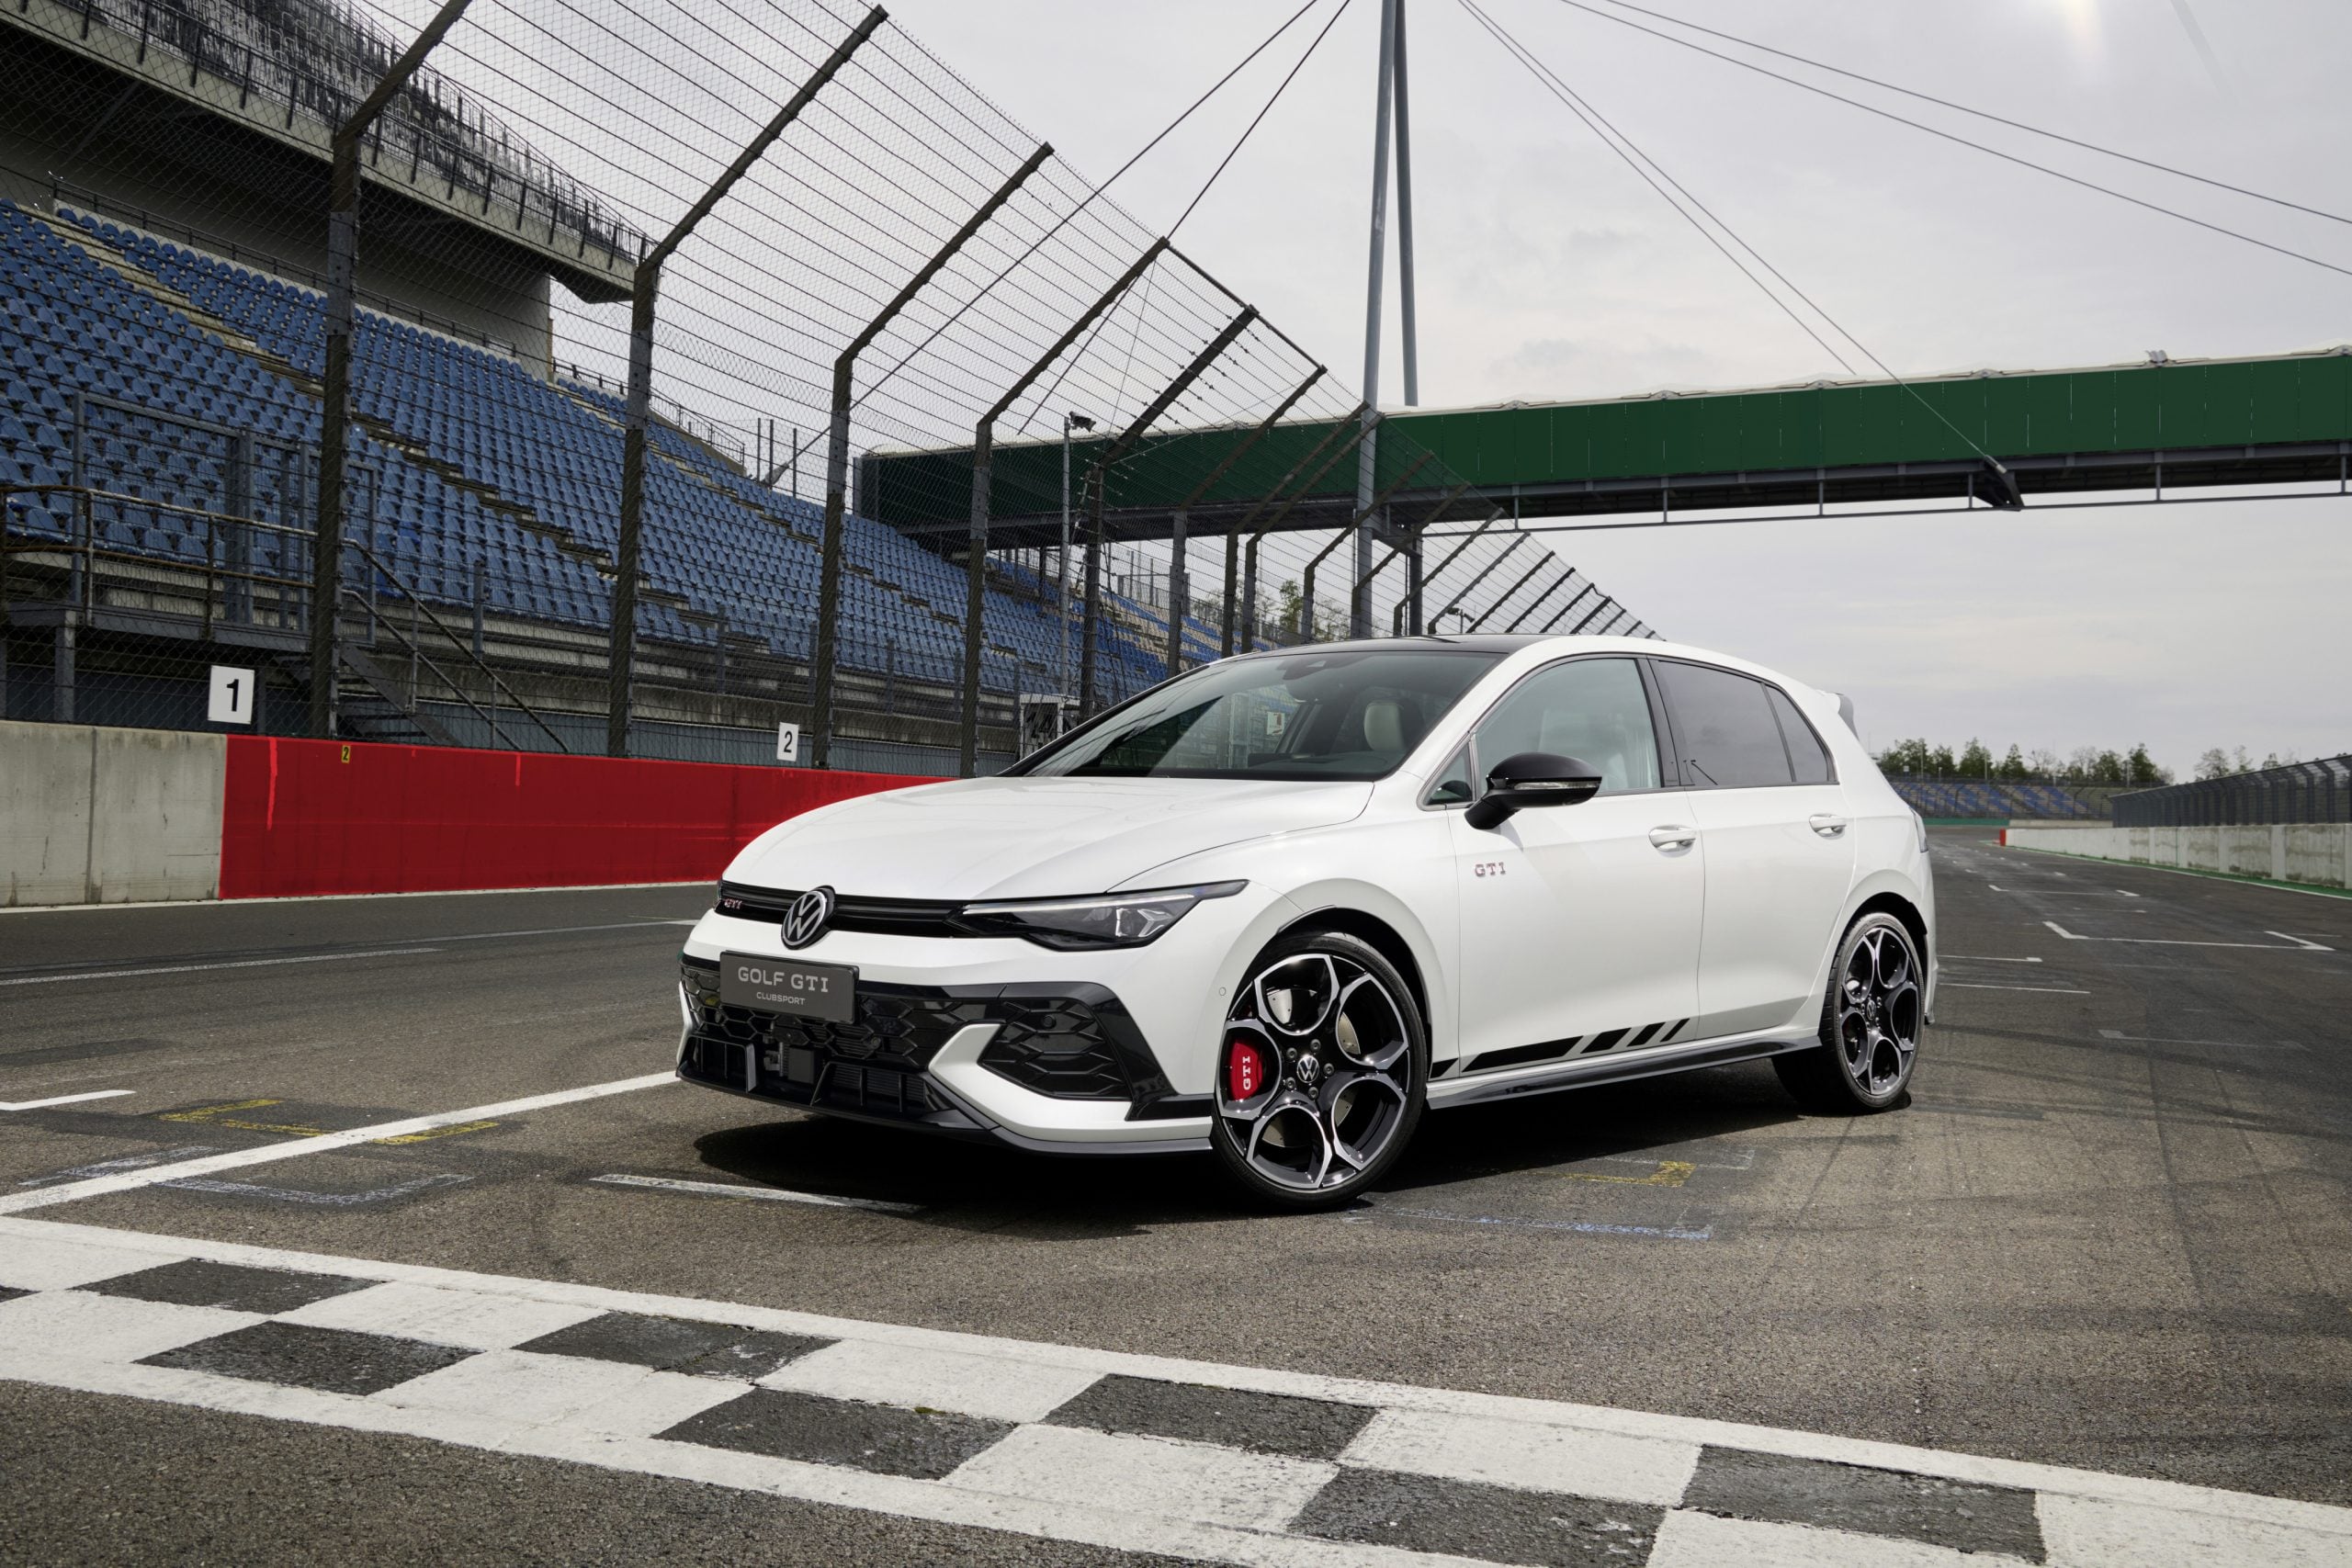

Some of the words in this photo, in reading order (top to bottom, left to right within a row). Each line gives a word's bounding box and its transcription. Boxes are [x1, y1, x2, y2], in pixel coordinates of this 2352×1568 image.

[226, 678, 239, 712] 1
[784, 730, 793, 753] 2
[343, 746, 349, 761] 2
[1474, 862, 1507, 877] GTI
[724, 898, 742, 909] GTI
[738, 965, 786, 987] GOLF
[790, 974, 829, 993] GTI
[756, 991, 806, 1006] CLUBSPORT
[1242, 1055, 1251, 1090] GTI
